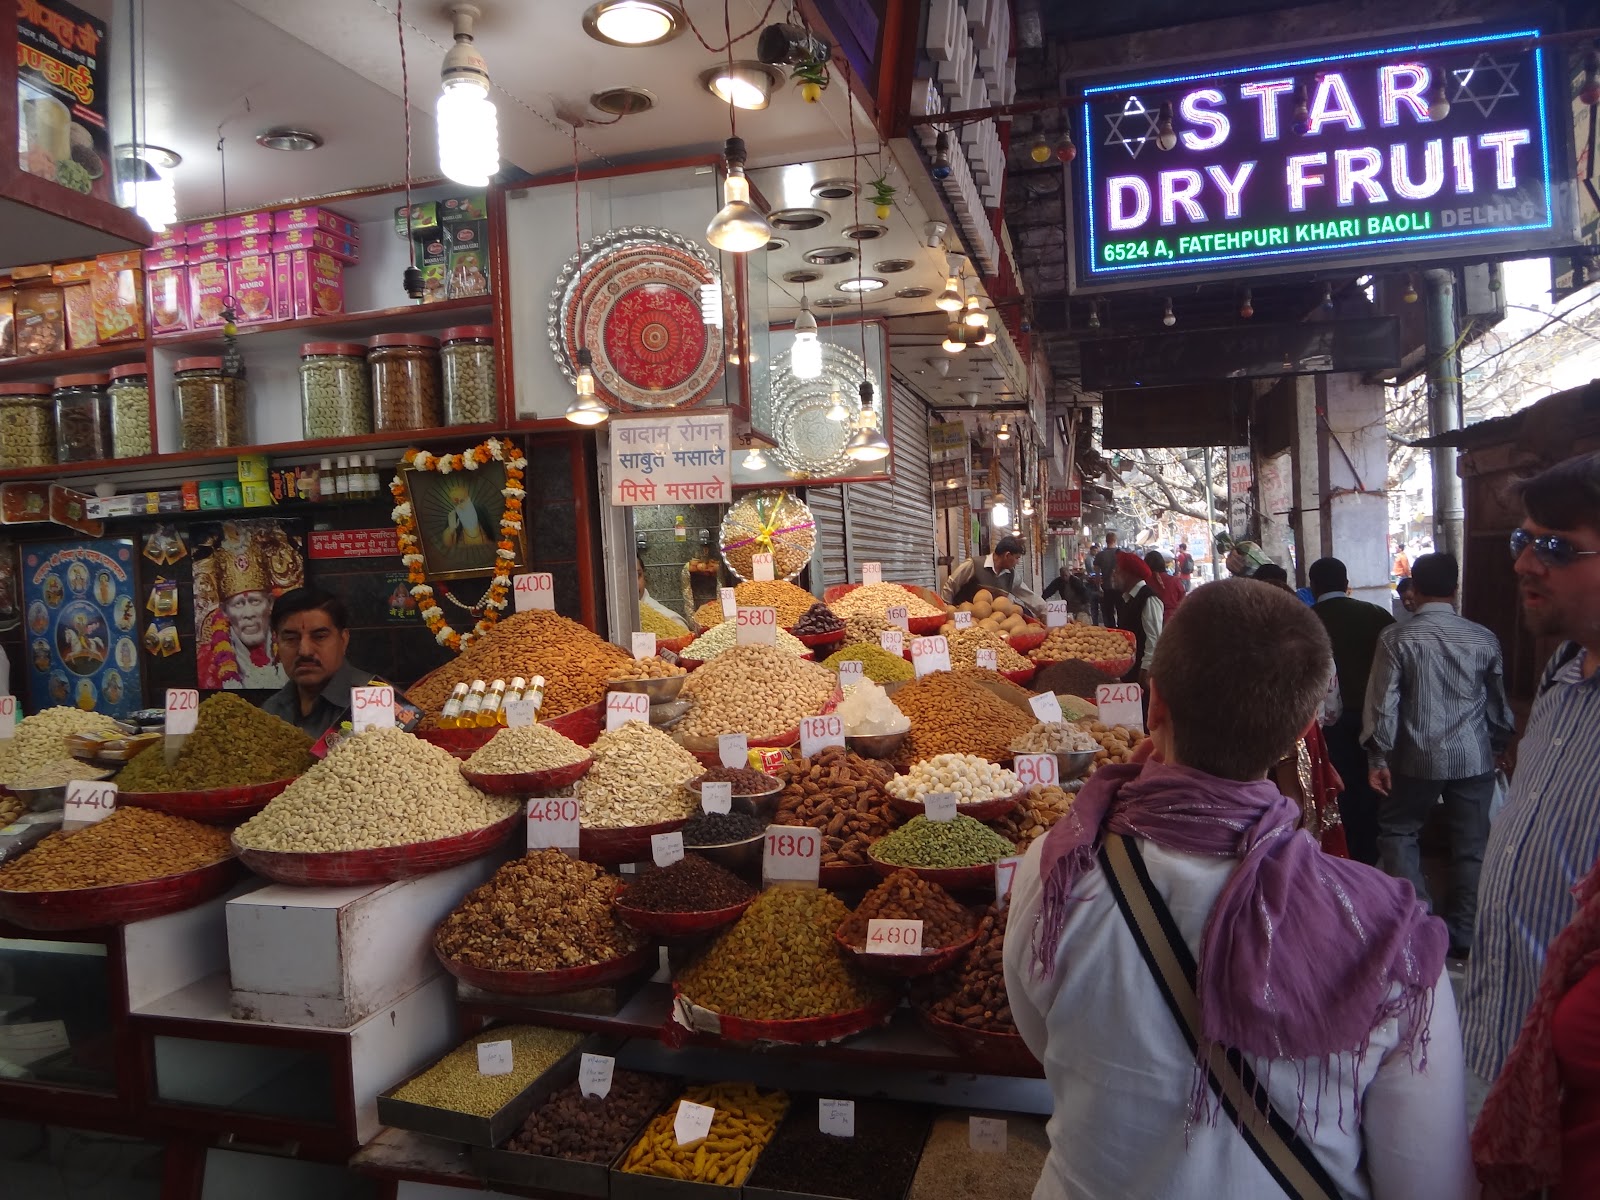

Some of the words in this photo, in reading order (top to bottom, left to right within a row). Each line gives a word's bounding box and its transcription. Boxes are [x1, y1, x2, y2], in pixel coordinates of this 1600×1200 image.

[1179, 62, 1434, 150] STAR
[1106, 160, 1257, 233] DRY
[1287, 128, 1530, 212] FRUIT
[1104, 240, 1149, 262] 6524
[1154, 238, 1173, 259] A,
[1179, 228, 1288, 253] FATEHPURI
[1295, 220, 1359, 242] KHARI
[1367, 211, 1431, 233] BAOLI
[1441, 201, 1535, 227] DELHI-6
[617, 425, 671, 444] बादाम
[677, 419, 724, 441] रोगन
[619, 451, 666, 474] साबुत
[672, 447, 725, 467] मसाले
[618, 478, 657, 502] पिसे
[664, 475, 724, 500] मसाले
[1049, 502, 1079, 512] FRUITS
[753, 554, 772, 564] 400
[515, 575, 553, 592] 400
[737, 609, 774, 626] 580
[887, 609, 907, 620] 160
[1048, 603, 1067, 613] 240
[976, 650, 996, 661] 480
[840, 662, 863, 673] 400
[168, 690, 198, 710] 220
[355, 688, 393, 709] 540
[608, 693, 650, 713] 440
[1100, 685, 1140, 704] 240
[0, 698, 14, 715] 0
[803, 716, 842, 739] 180
[1017, 756, 1055, 785] 80
[66, 790, 117, 810] 440
[528, 800, 579, 822] 480
[768, 833, 815, 857] 180
[870, 926, 918, 945] 480
